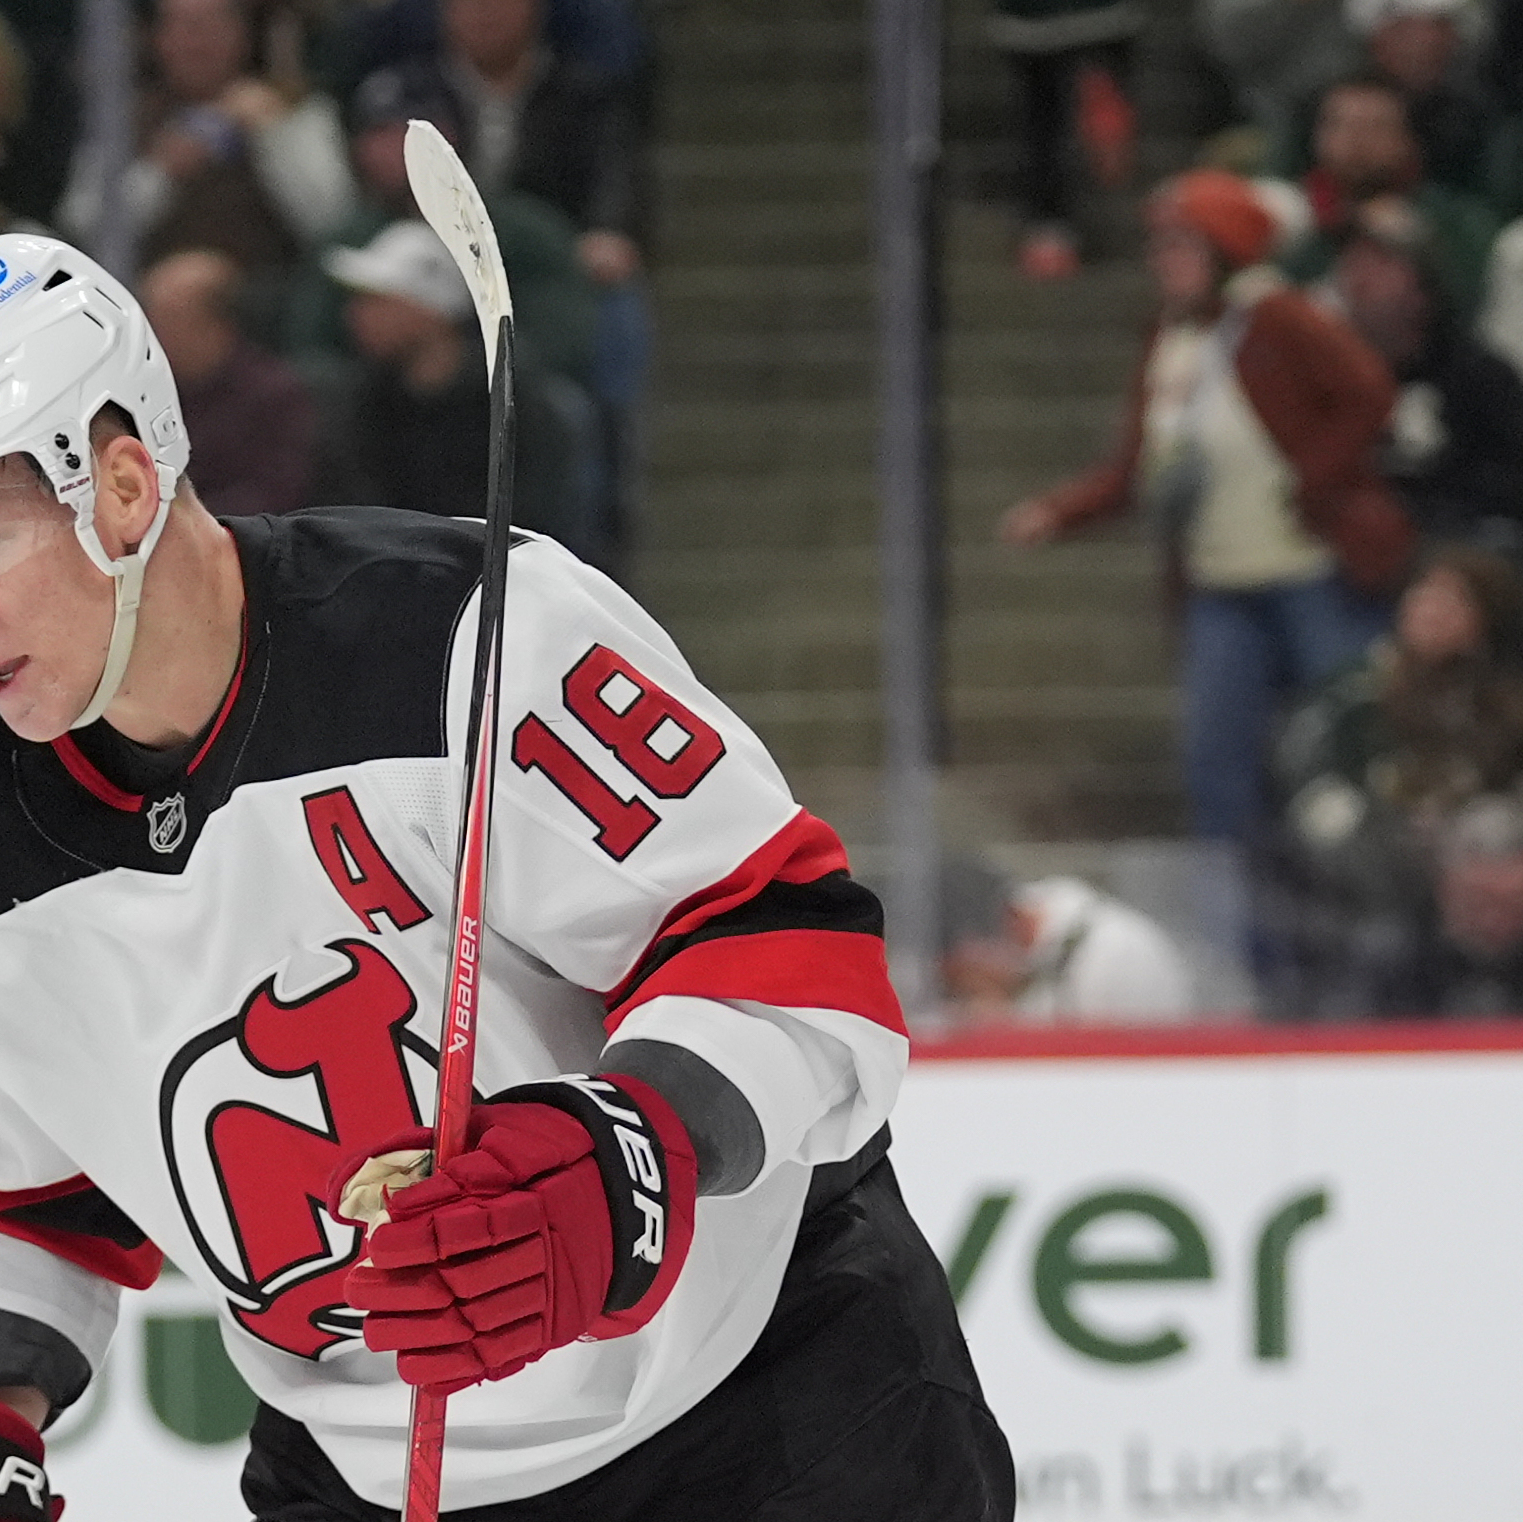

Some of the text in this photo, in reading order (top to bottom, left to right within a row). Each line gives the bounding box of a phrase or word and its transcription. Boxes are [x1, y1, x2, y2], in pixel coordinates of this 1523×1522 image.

[59, 476, 90, 494] BAUER
[510, 642, 727, 863] 18
[300, 784, 434, 937] A
[454, 918, 478, 1032] BAUER
